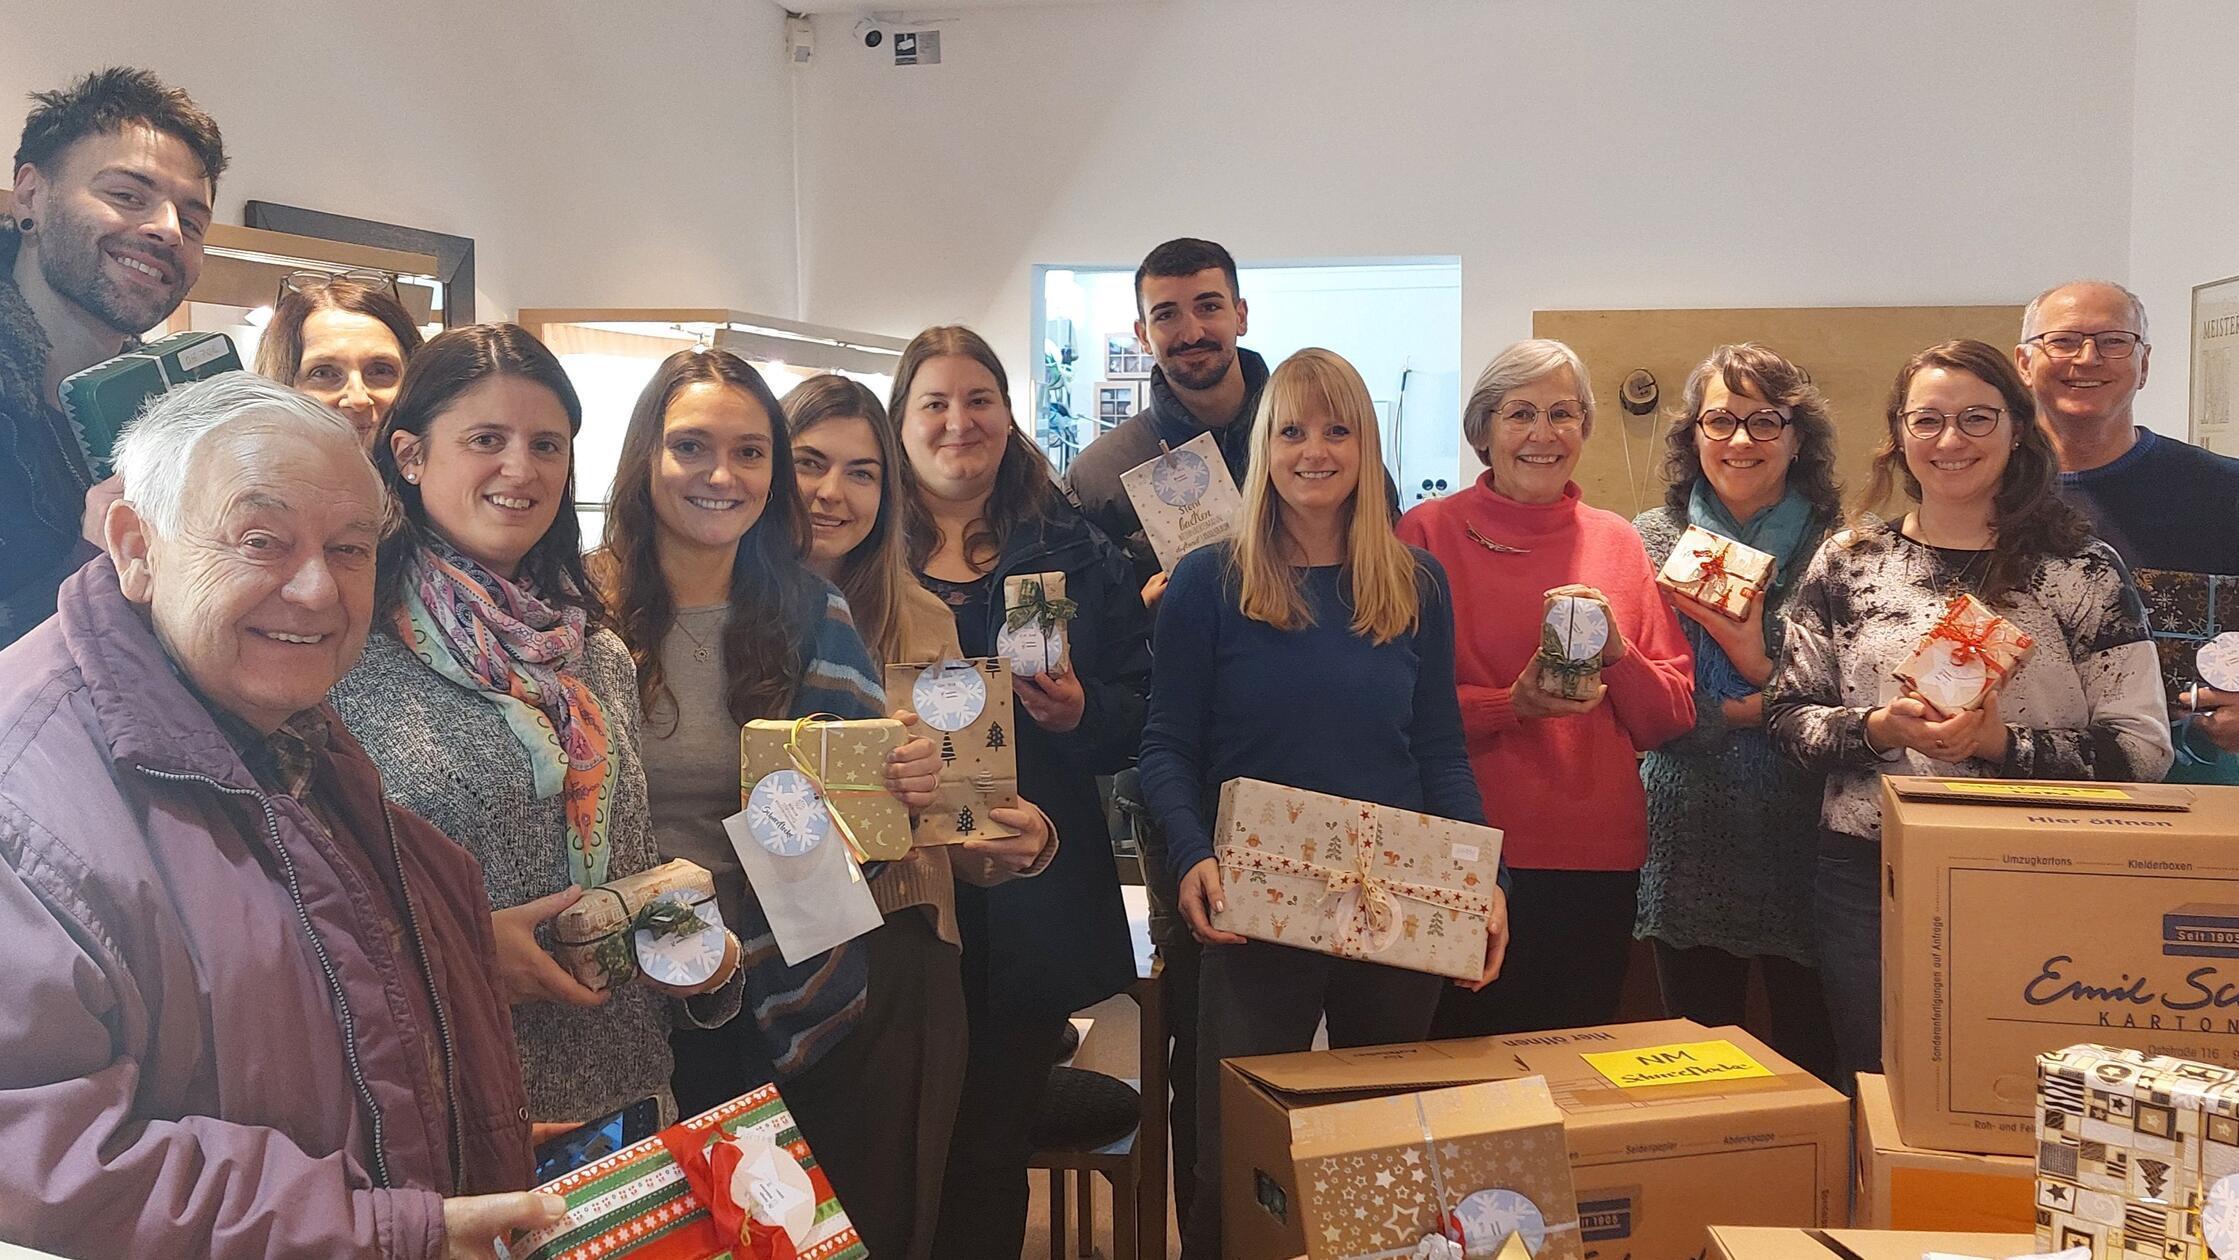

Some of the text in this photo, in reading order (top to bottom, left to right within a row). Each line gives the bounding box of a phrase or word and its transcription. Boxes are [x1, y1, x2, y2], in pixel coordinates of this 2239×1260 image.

[2027, 815, 2173, 828] Hier öffnen
[2003, 854, 2193, 872] Umzugkartons Kleiderboxen
[2178, 930, 2204, 941] Seit
[2024, 955, 2155, 1005] Emil
[1931, 916, 1944, 1062] Sonderanfertigungen auf Anfrage
[1635, 1050, 1699, 1066] NM
[1999, 1123, 2017, 1132] und
